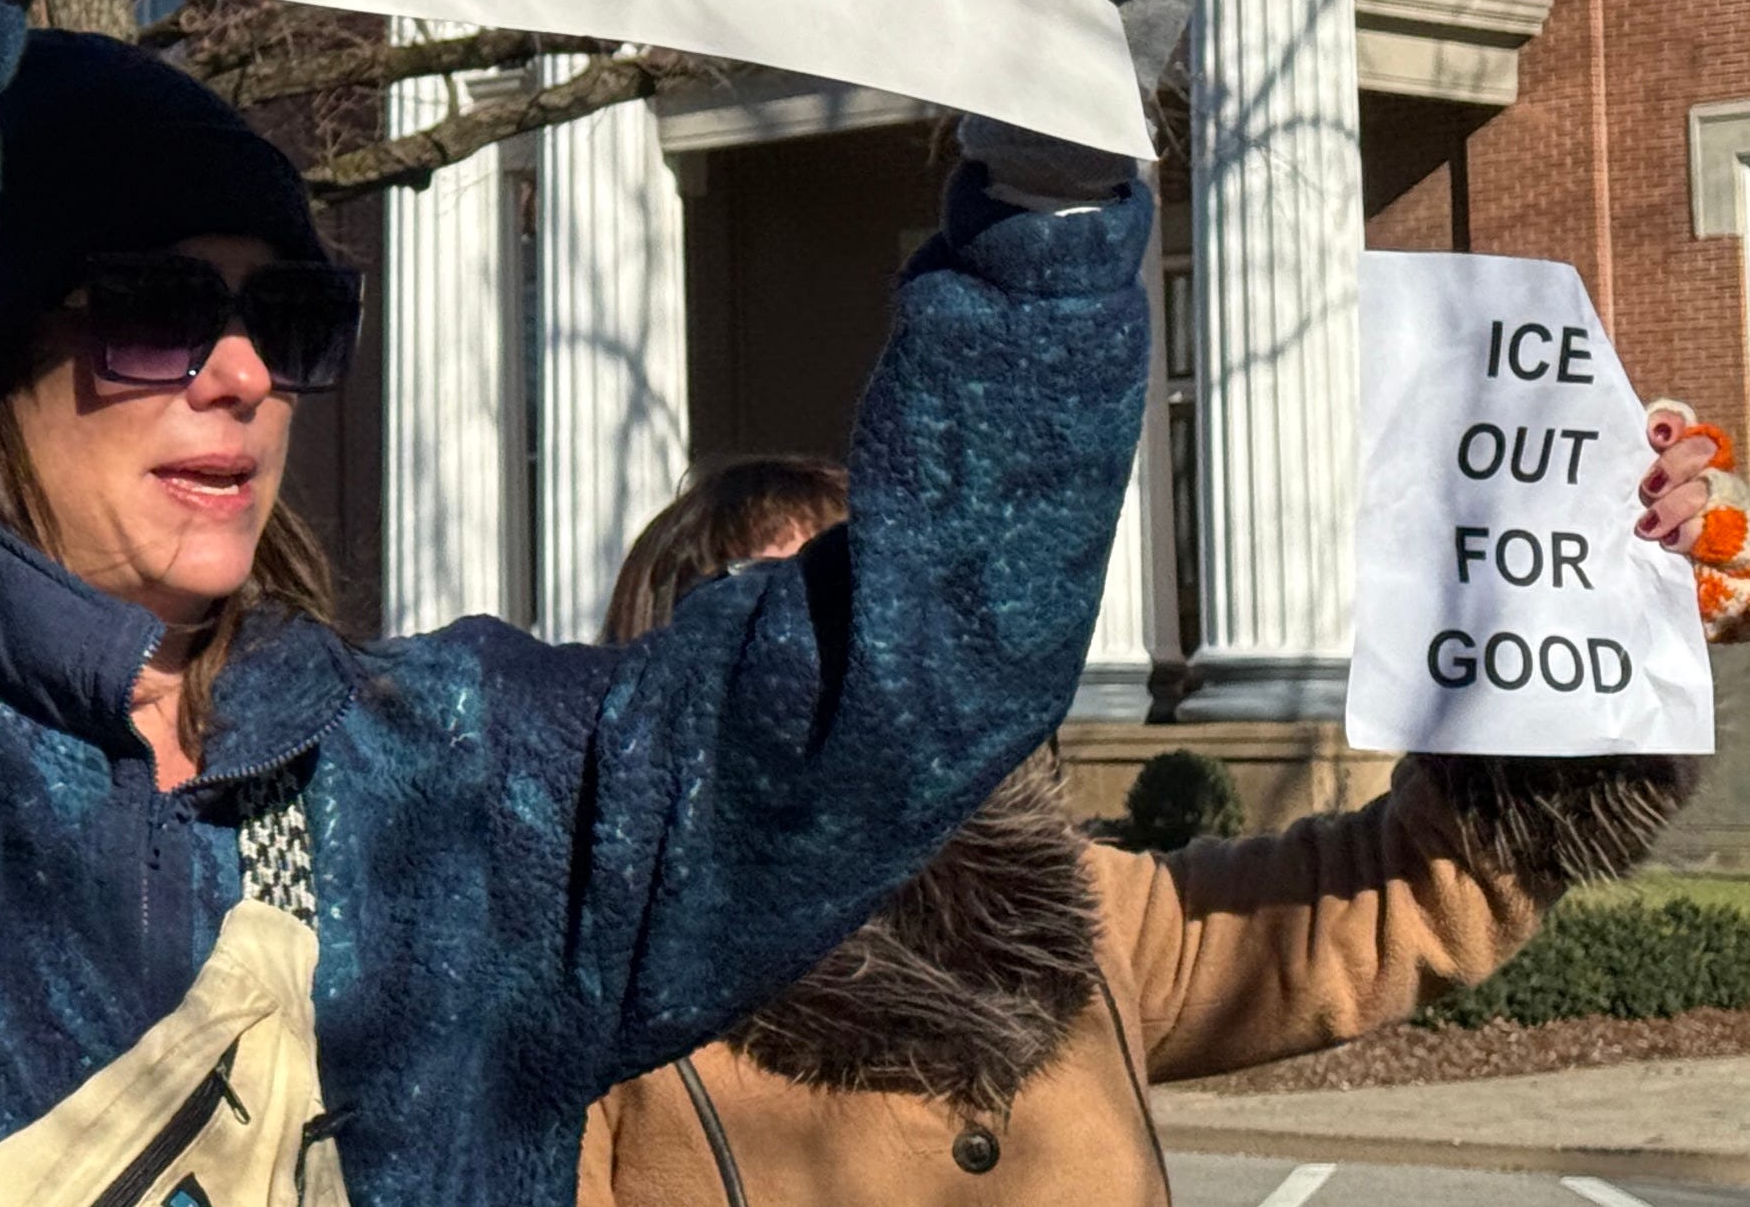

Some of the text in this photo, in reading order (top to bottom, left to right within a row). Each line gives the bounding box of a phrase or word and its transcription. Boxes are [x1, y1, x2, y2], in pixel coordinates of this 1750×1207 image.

[1486, 319, 1594, 385] ICE
[1456, 421, 1600, 484] OUT
[1453, 525, 1594, 590] FOR
[1426, 629, 1633, 694] GOOD
